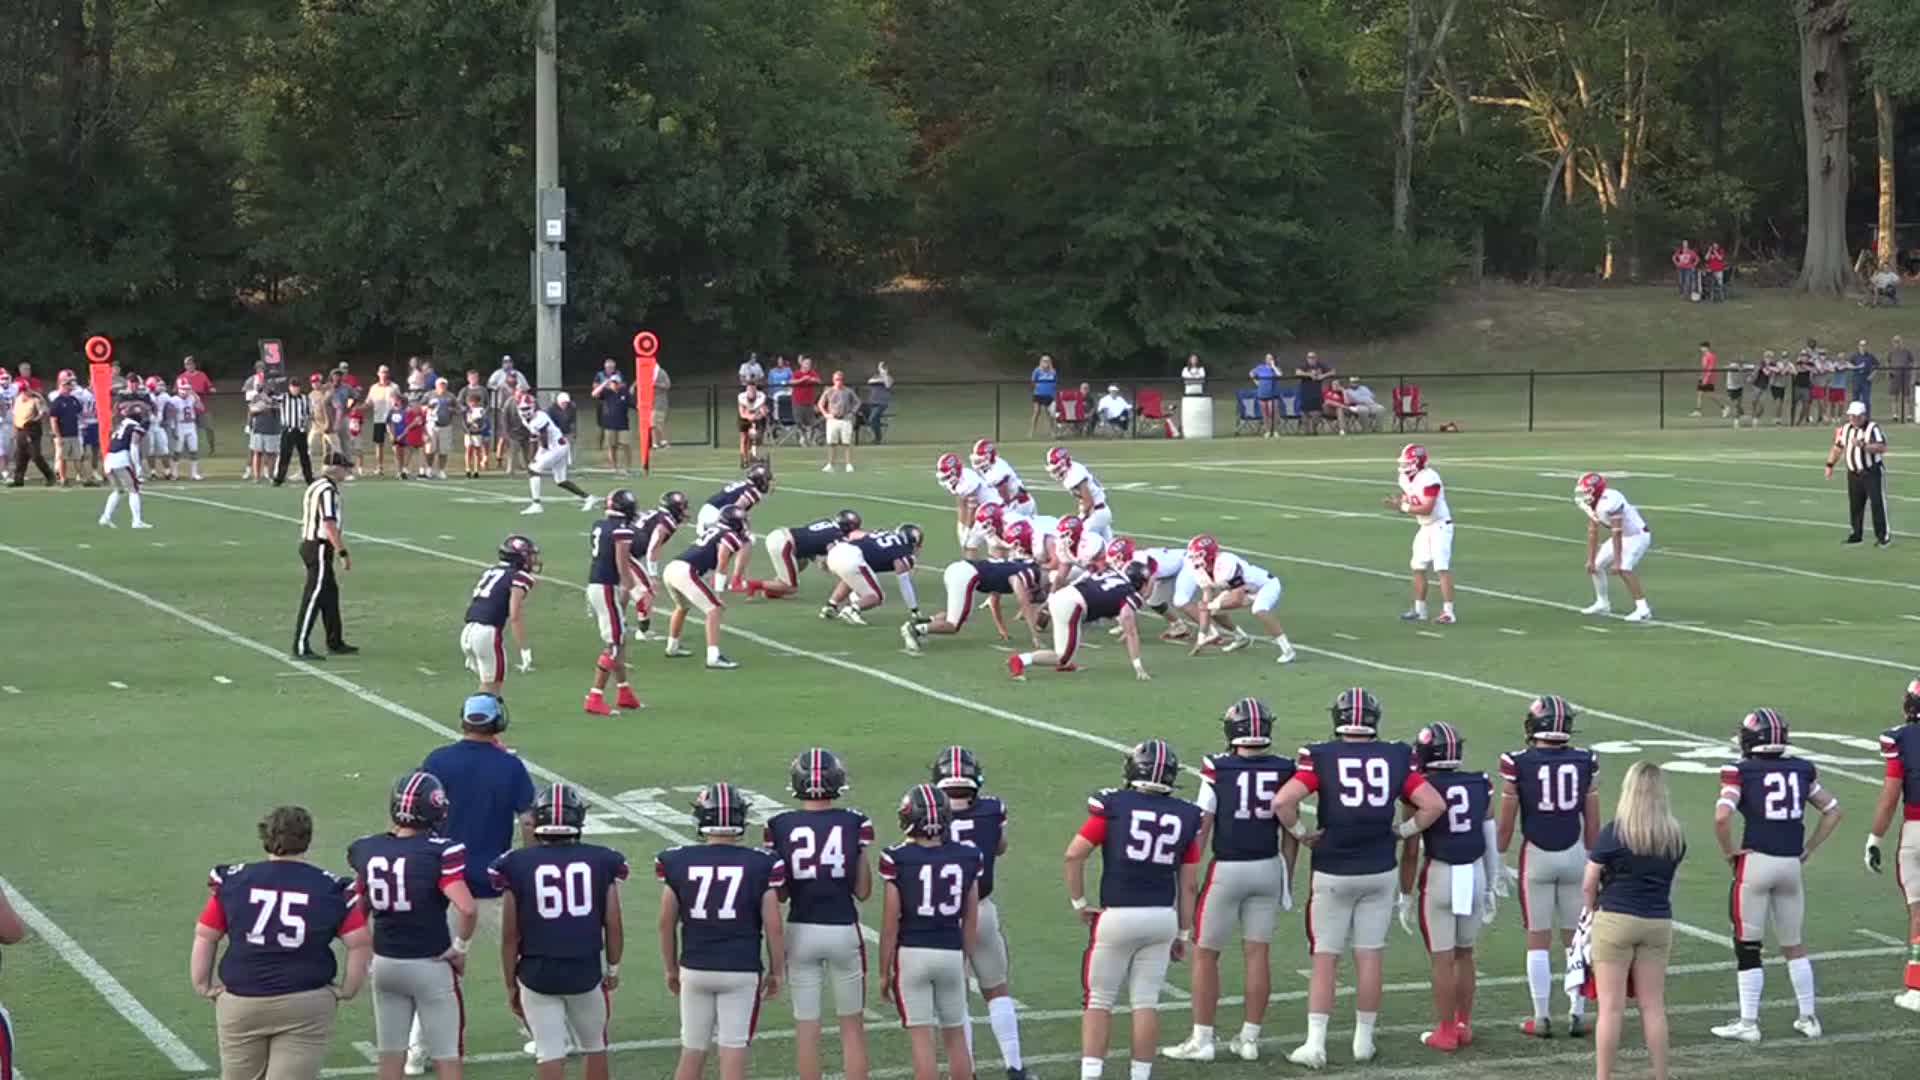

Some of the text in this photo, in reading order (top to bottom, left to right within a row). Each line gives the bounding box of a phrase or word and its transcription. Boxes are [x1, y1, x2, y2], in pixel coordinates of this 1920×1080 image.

[263, 342, 281, 364] 3
[1234, 771, 1279, 819] 15
[1338, 757, 1390, 807] 59
[1537, 764, 1579, 811] 10
[1763, 771, 1802, 820] 21
[1446, 785, 1472, 832] 2
[789, 826, 846, 879] 24
[1125, 810, 1182, 865] 52
[366, 856, 411, 911] 61
[535, 862, 593, 919] 60
[688, 866, 744, 919] 77
[917, 864, 963, 916] 13
[246, 888, 309, 948] 75
